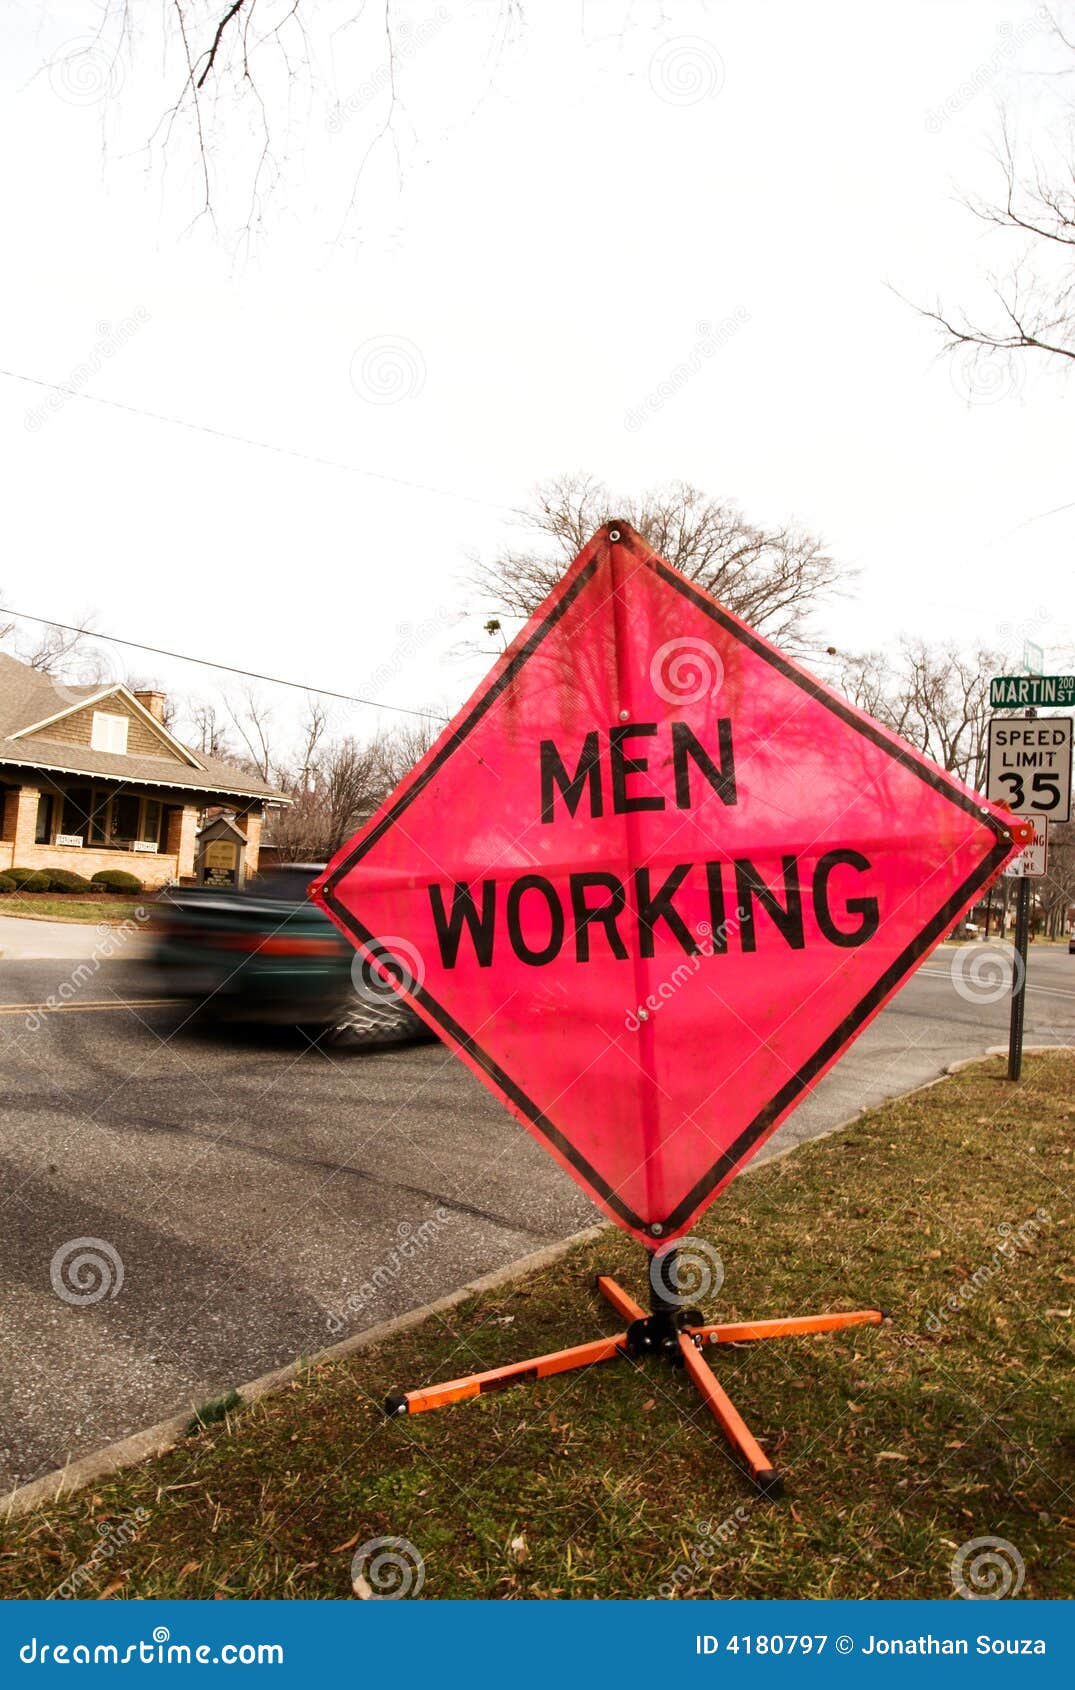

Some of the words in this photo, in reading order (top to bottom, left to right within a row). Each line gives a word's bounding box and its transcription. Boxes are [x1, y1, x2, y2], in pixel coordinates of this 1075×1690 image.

[991, 679, 1056, 703] MARTIN
[1058, 677, 1075, 689] 200
[1057, 690, 1075, 702] ST
[995, 730, 1066, 746] SPEED
[539, 718, 739, 825] MEN
[1002, 751, 1057, 767] LIMIT
[998, 772, 1061, 811] 35
[428, 848, 881, 970] WORKING
